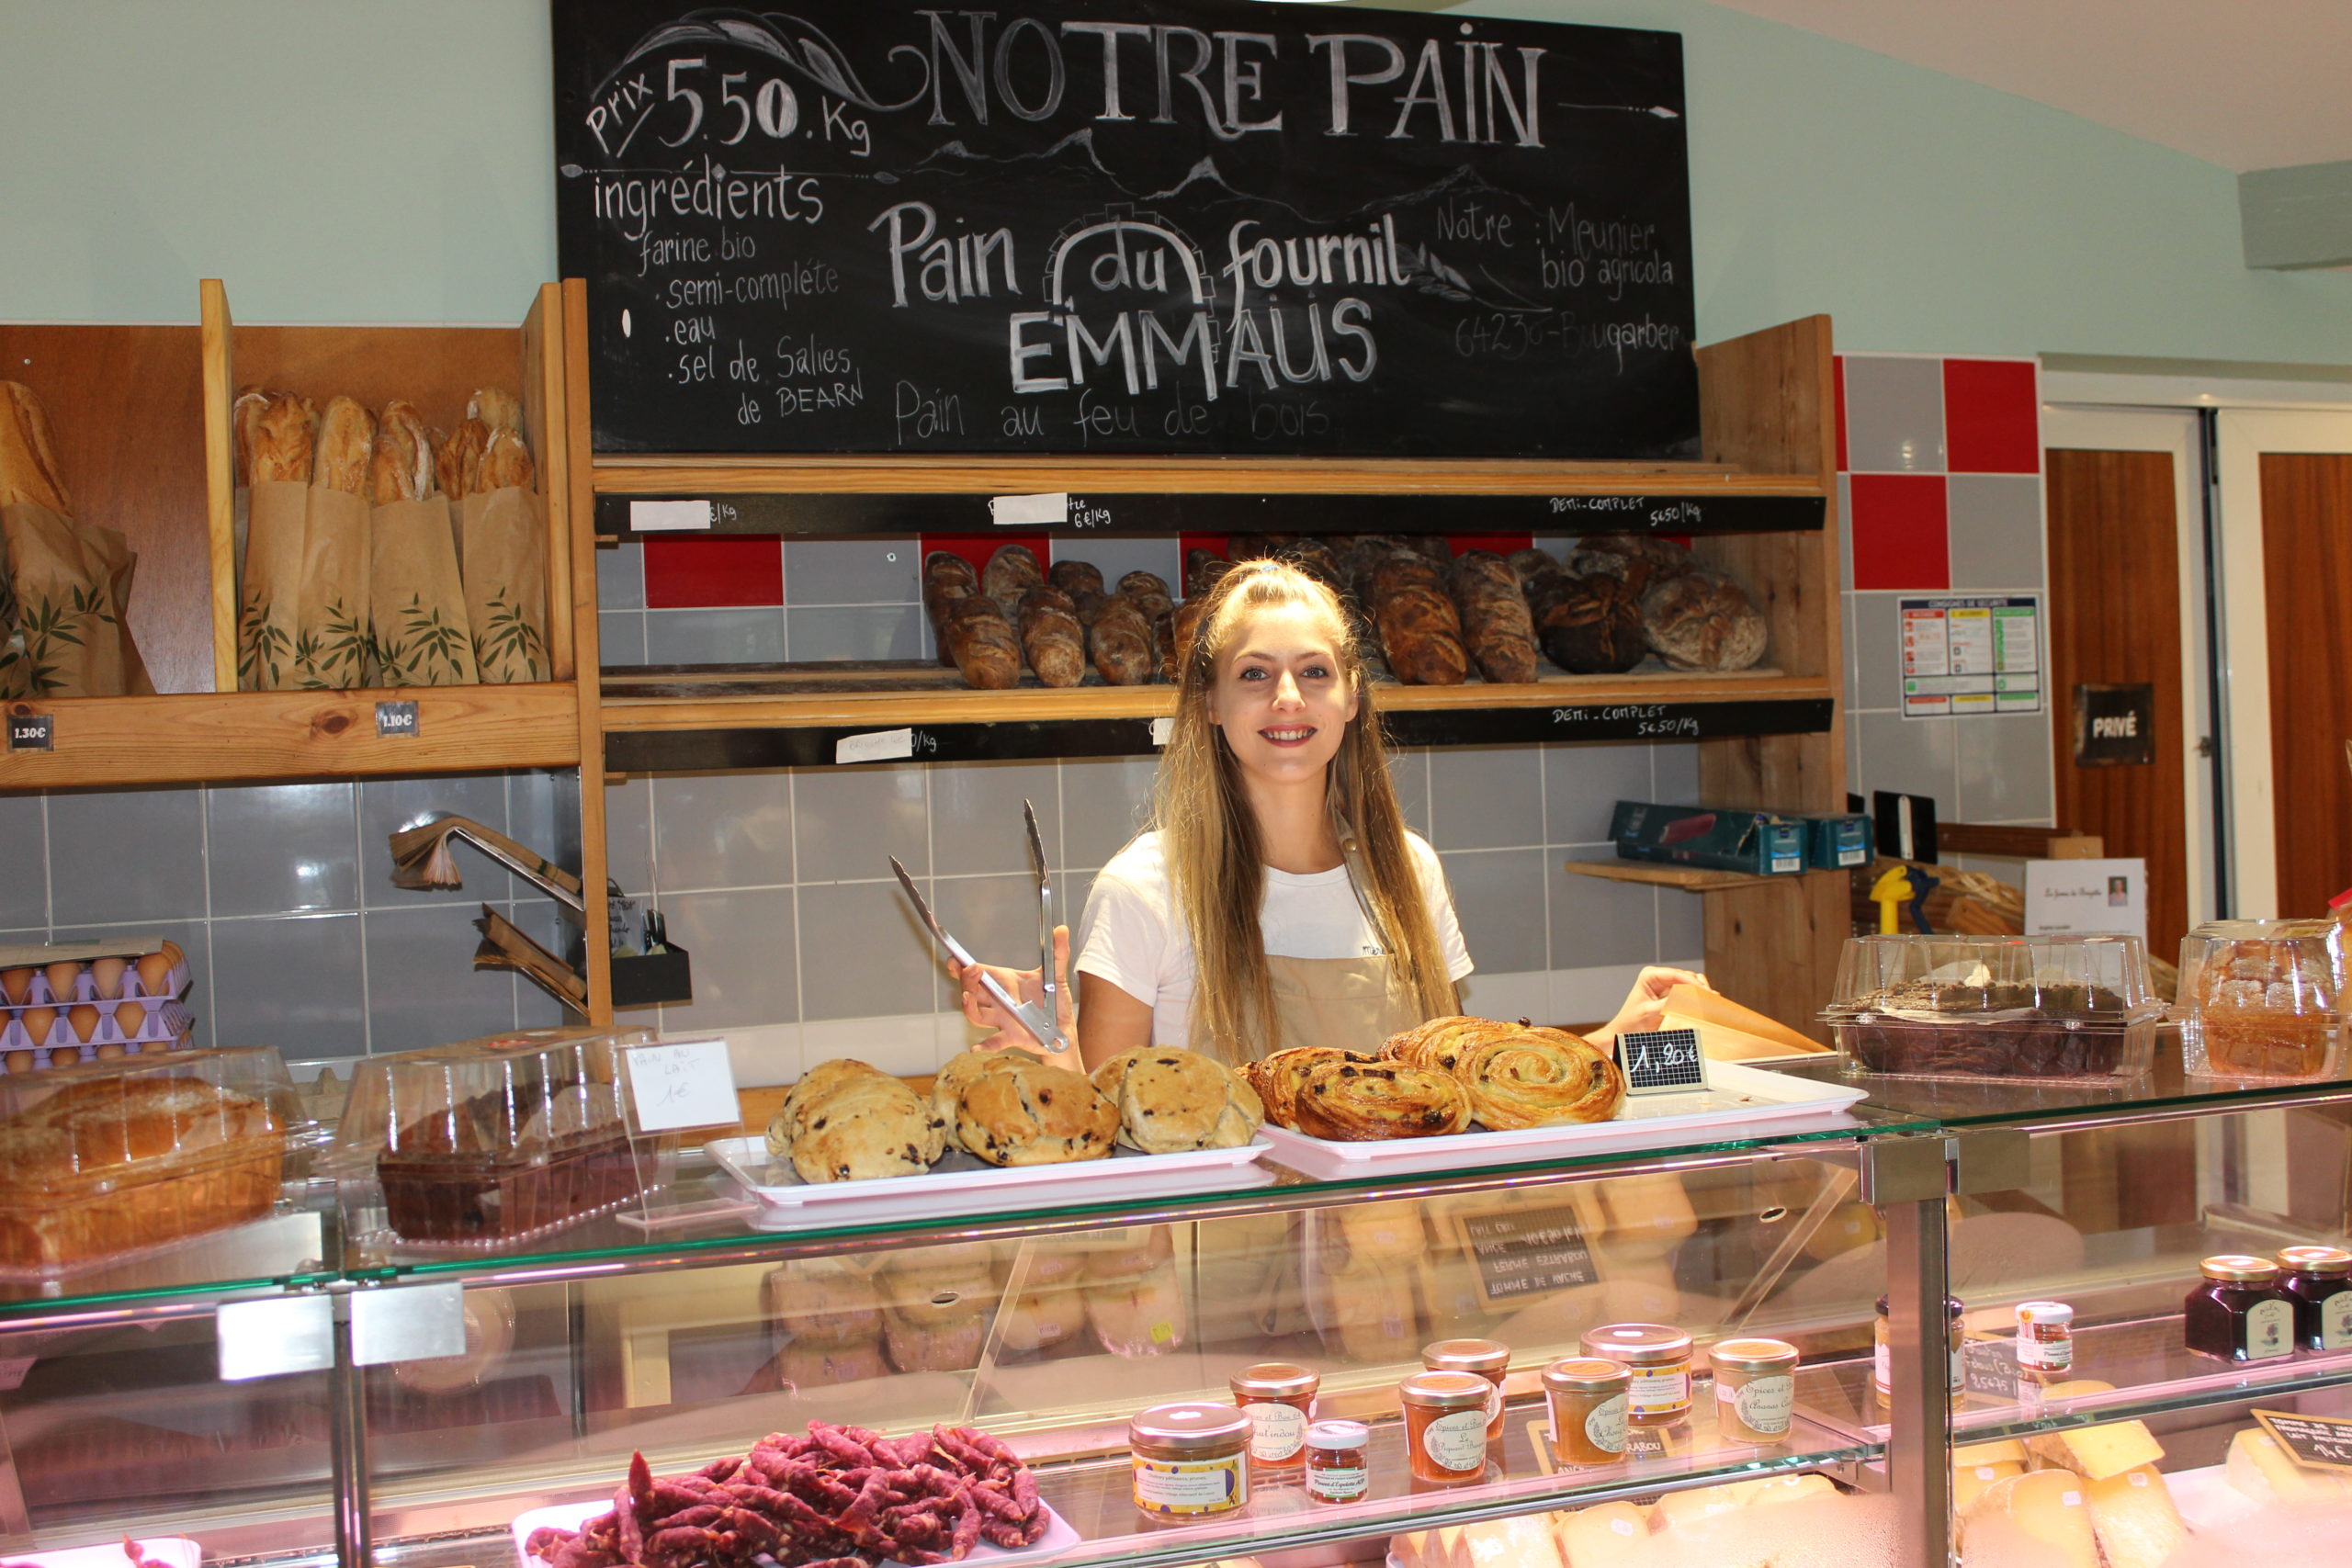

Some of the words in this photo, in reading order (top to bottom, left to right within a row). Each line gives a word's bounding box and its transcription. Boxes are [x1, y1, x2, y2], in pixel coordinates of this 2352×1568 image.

[914, 9, 1283, 141] NOTRE
[585, 73, 653, 155] Prix
[594, 153, 823, 242] ingrédients
[638, 230, 711, 277] farine
[721, 226, 756, 261] bio
[1436, 197, 1515, 248] Notre
[1547, 200, 1657, 261] Meunier
[867, 200, 1023, 308] Pain
[1090, 214, 1169, 294] du
[1222, 212, 1411, 333] fournil
[1541, 247, 1586, 288] bio
[1597, 248, 1674, 301] agricola
[729, 338, 761, 383] de
[776, 333, 851, 378] Salies
[737, 392, 762, 425] de
[775, 367, 864, 418] BEARN
[895, 379, 965, 446] Pain
[1001, 405, 1045, 437] au
[1073, 388, 1141, 448] feu
[1163, 379, 1213, 436] de
[1248, 384, 1330, 441] bois
[15, 727, 46, 739] 1.30€
[2092, 709, 2138, 739] PRIVÉ
[1629, 1042, 1698, 1074] 1,20€
